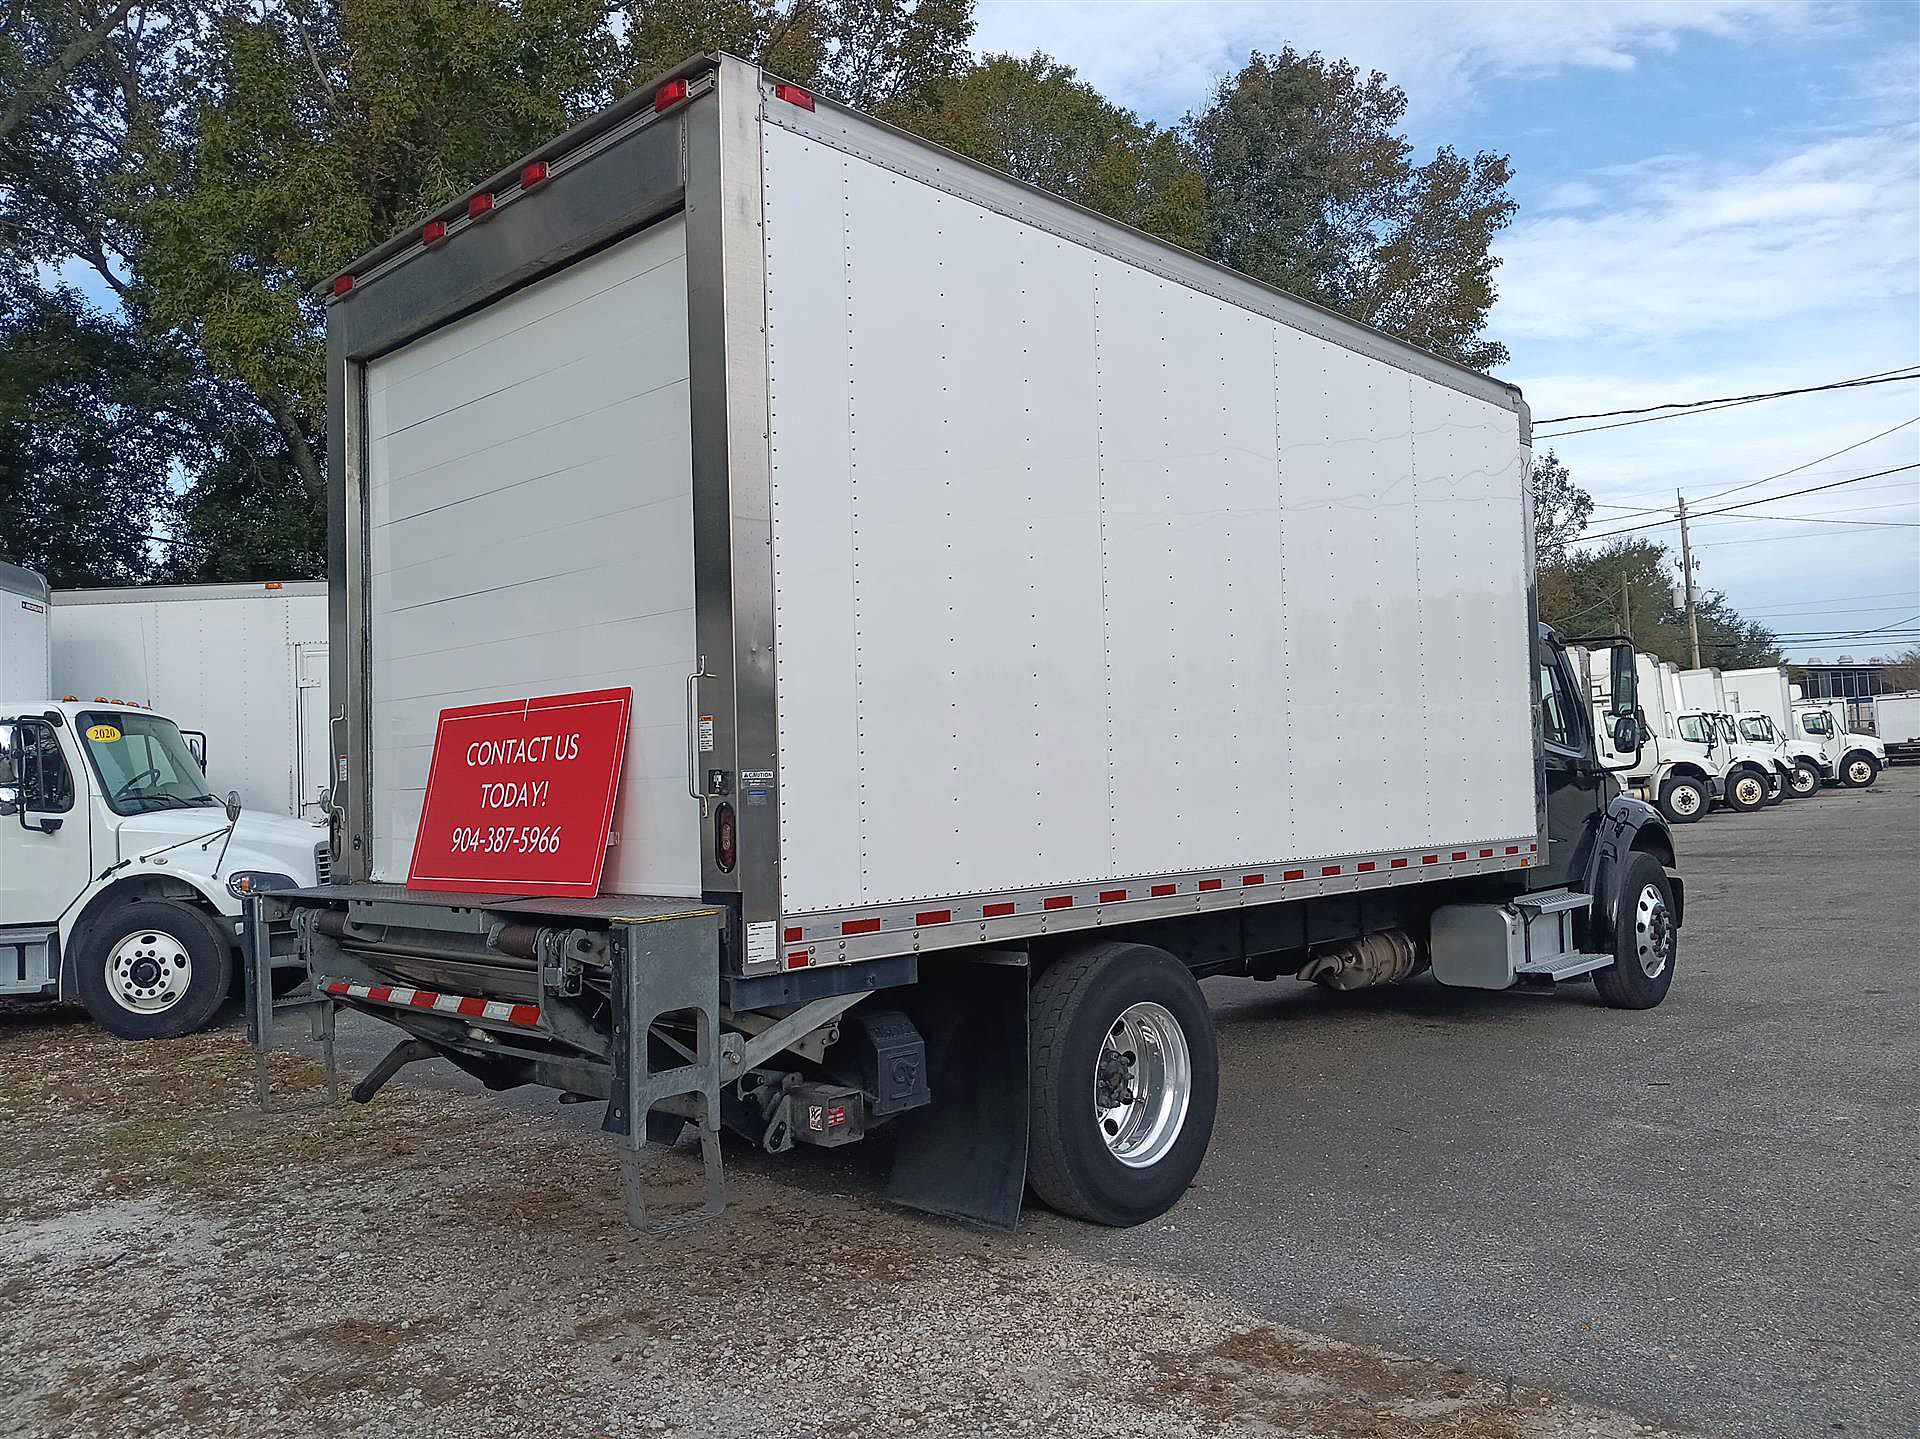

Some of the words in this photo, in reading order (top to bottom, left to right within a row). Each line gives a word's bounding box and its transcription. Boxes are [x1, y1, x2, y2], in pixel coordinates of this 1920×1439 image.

[94, 728, 115, 739] 2020
[466, 736, 552, 766] CONTACT
[555, 733, 580, 761] US
[481, 780, 549, 809] TODAY!
[451, 826, 561, 853] 904-387-5966
